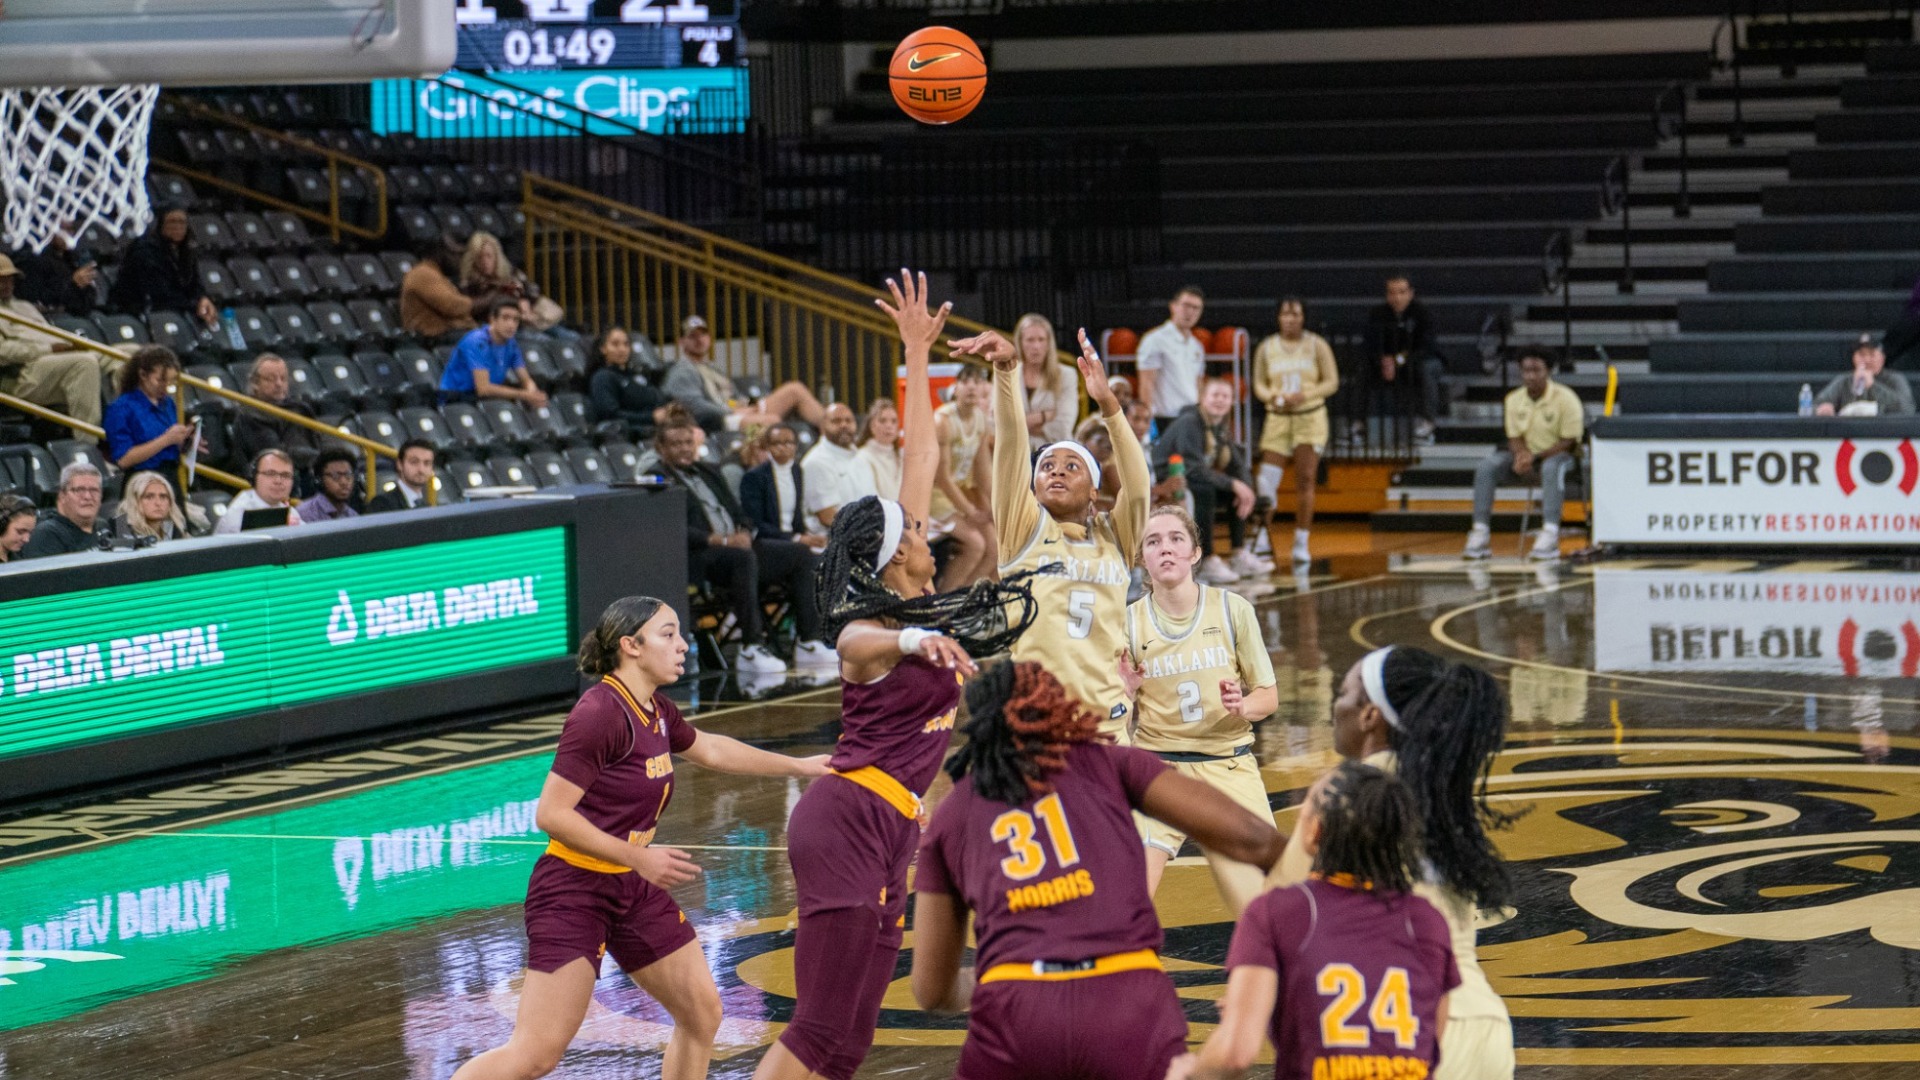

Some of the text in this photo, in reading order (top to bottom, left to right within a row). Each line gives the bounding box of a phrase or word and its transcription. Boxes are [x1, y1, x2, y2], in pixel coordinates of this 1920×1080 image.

[503, 28, 616, 66] 01:49
[698, 41, 720, 67] 4
[420, 75, 690, 130] Great Clips
[908, 86, 962, 102] ELITE
[1647, 451, 1820, 485] BELFOR
[1038, 554, 1124, 585] OKLAN
[364, 575, 539, 640] DELTA DENTAL
[1066, 590, 1096, 640] 5
[13, 623, 225, 698] DELTA DENTAL
[1176, 680, 1204, 723] 2
[989, 791, 1081, 881] 31
[1006, 868, 1096, 913] NORRIS
[1316, 962, 1420, 1050] 24
[1311, 1055, 1430, 1080] ANDERSO
